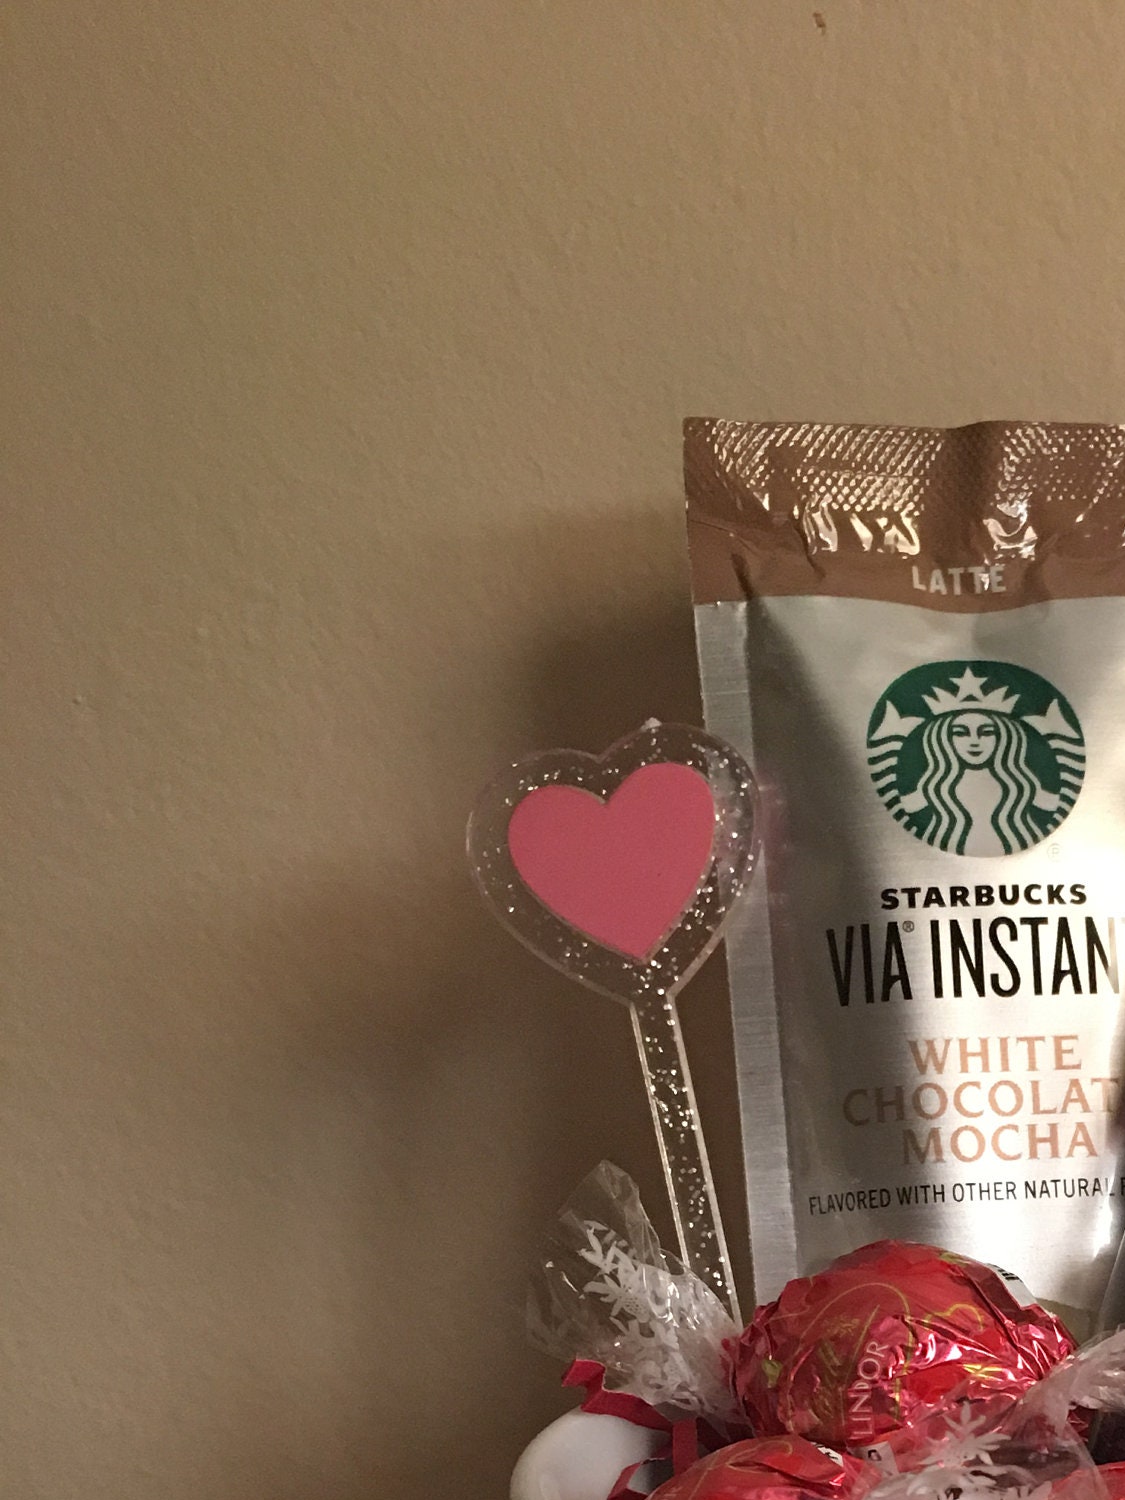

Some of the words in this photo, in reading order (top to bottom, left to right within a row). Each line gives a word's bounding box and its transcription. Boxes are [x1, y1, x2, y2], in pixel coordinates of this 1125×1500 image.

[912, 565, 1007, 595] LATTE
[881, 883, 1088, 910] STARBUCKS
[907, 1034, 1083, 1075] WHITE
[901, 1121, 1100, 1166] MOCHA
[808, 1187, 892, 1216] FLAVORED
[896, 1182, 946, 1207] WITH
[952, 1181, 1018, 1203] OTHER
[1024, 1177, 1115, 1200] NATURAL
[850, 1341, 889, 1435] LINDOR
